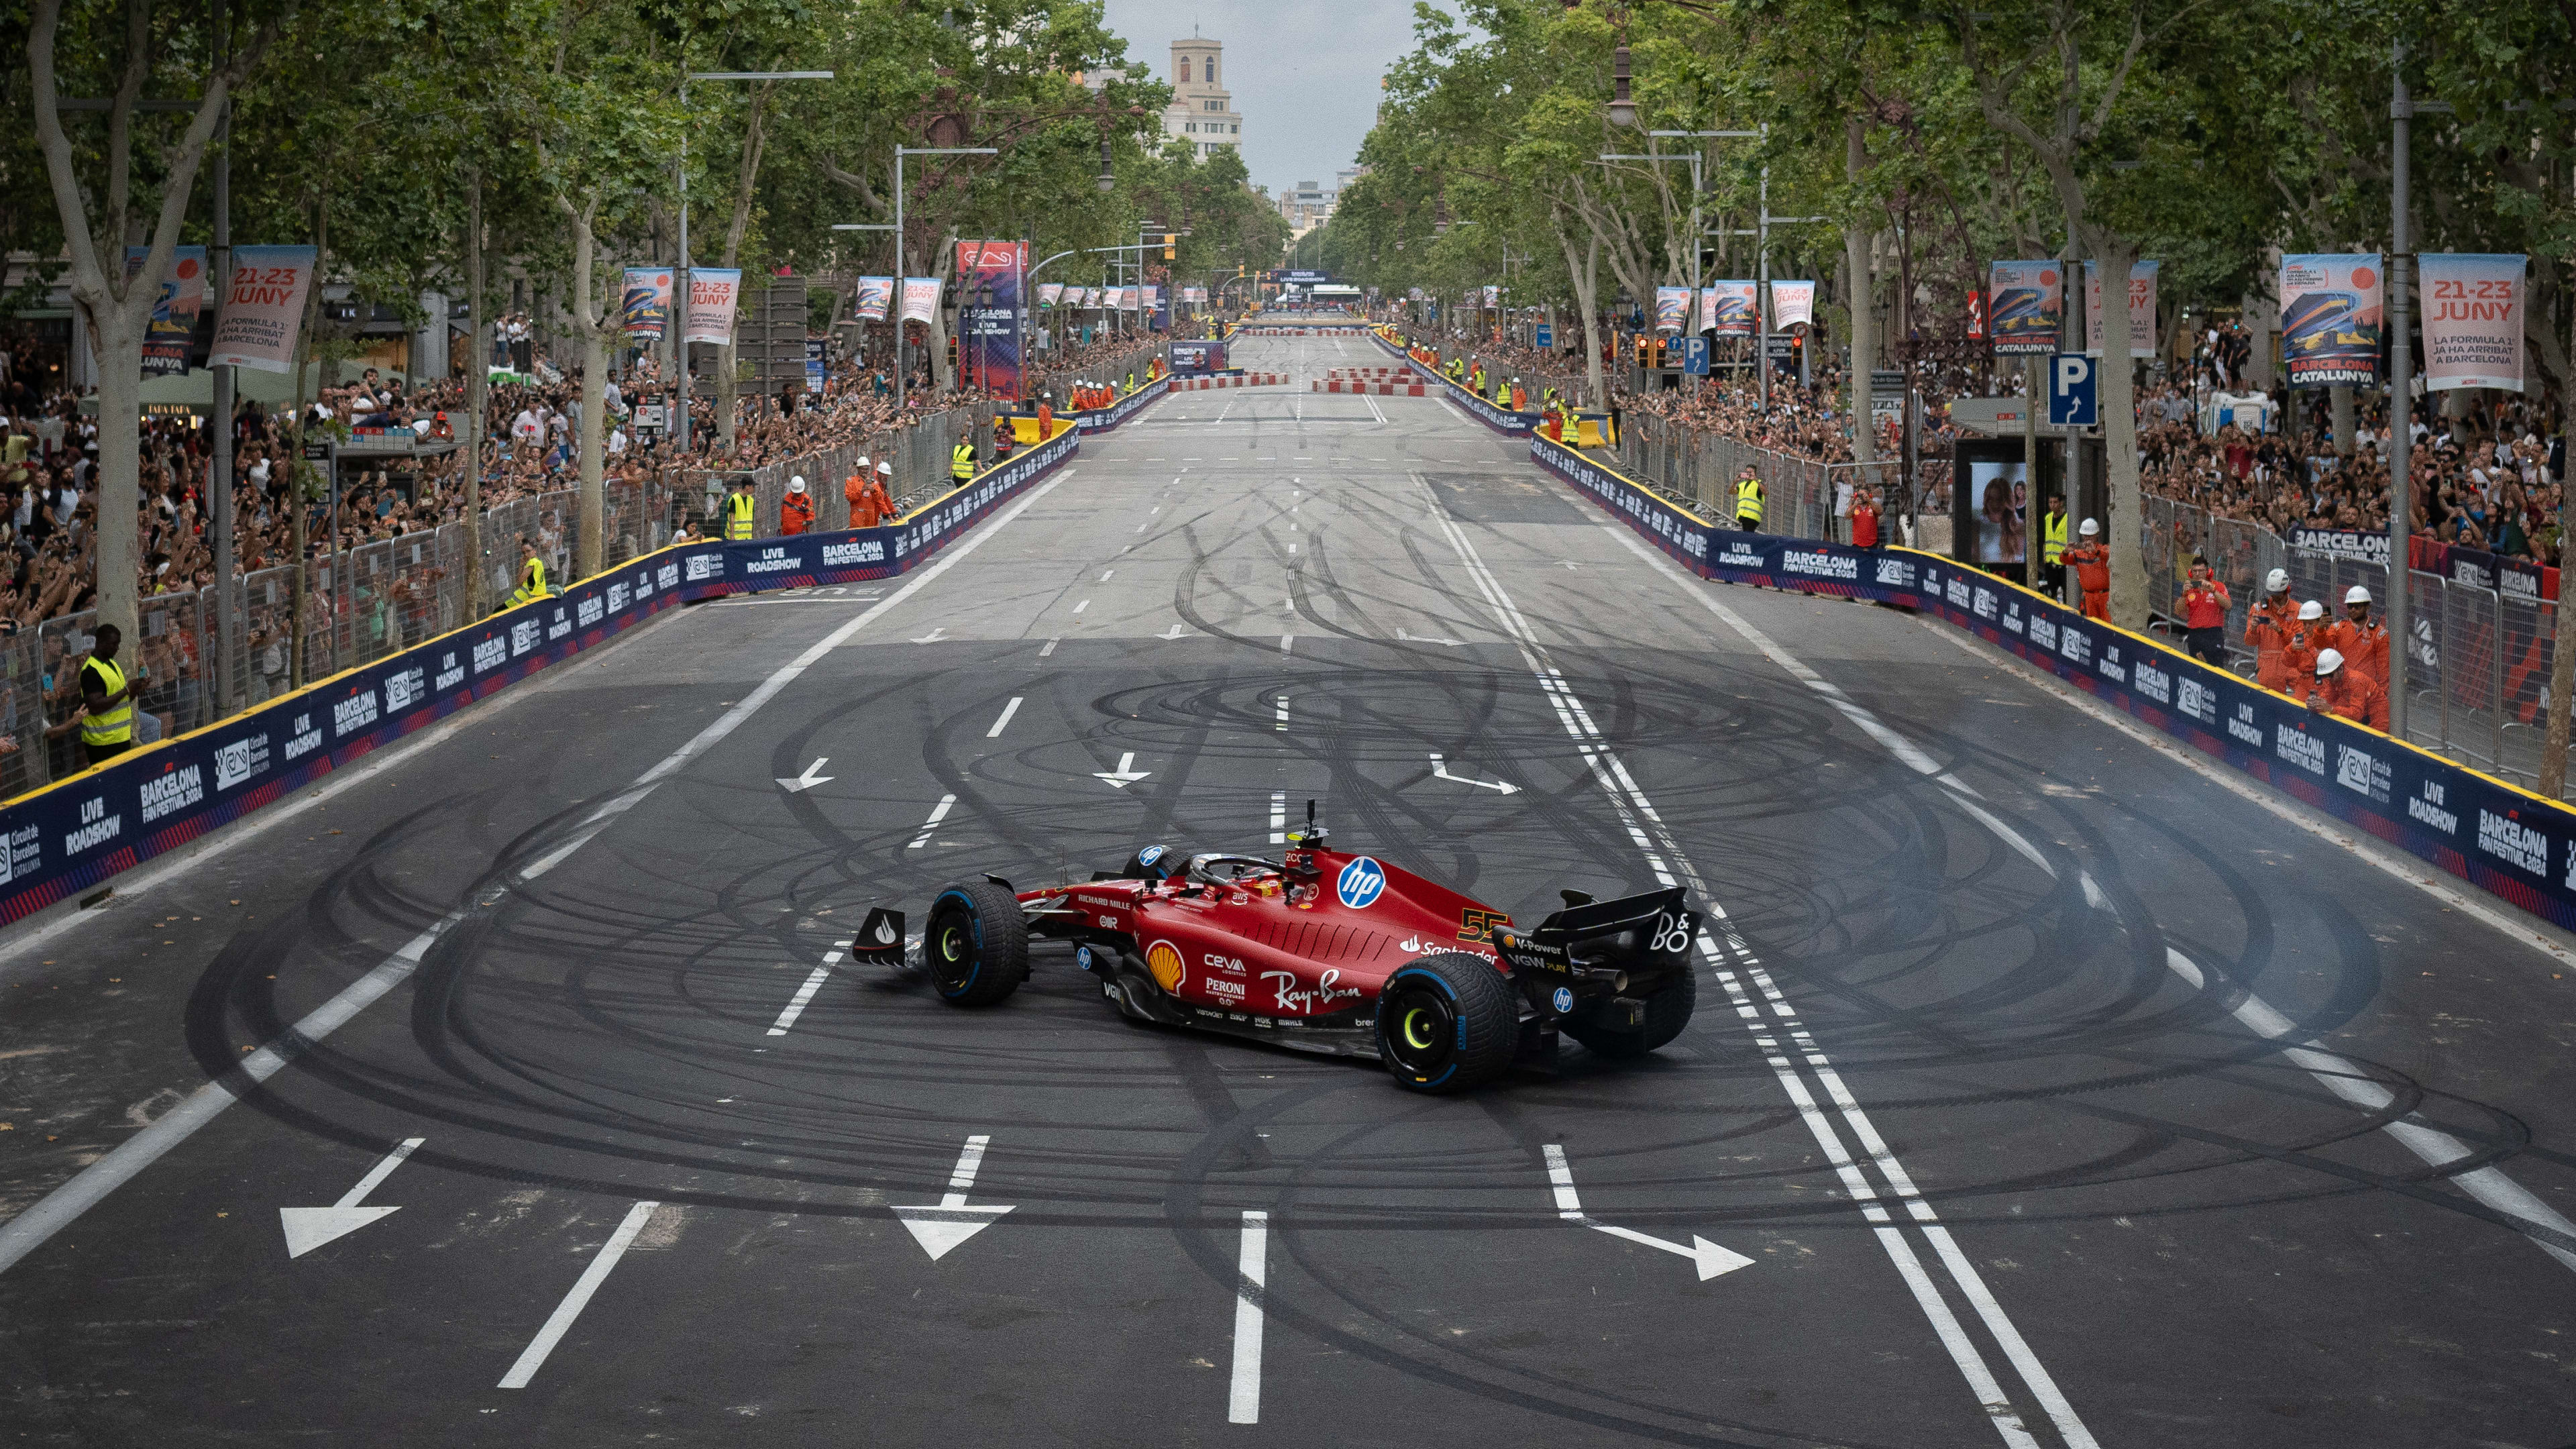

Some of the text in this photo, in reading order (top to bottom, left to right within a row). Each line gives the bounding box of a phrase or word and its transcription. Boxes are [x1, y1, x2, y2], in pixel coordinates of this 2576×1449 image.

[235, 268, 297, 286] 21-23
[228, 287, 294, 307] JUNY
[693, 282, 731, 294] 21-23
[2434, 280, 2512, 299] 21-23
[690, 294, 730, 306] JUNY
[1777, 294, 1808, 304] JUNY
[2433, 302, 2513, 321] JUNY
[230, 317, 278, 328] FORMULA
[1688, 339, 1705, 358] P
[1995, 343, 2056, 353] CATALUNYA
[1996, 337, 2055, 345] BARCELONA
[2434, 336, 2447, 345] LA
[2450, 335, 2506, 345] FORMULA
[2434, 345, 2445, 356] JA
[2467, 345, 2514, 355] ARRIBAT
[2436, 354, 2512, 365] A BARCELONA
[2291, 359, 2373, 372] BARCELONA
[2059, 358, 2088, 396] P
[2292, 370, 2373, 384] CATALUNYA
[823, 541, 883, 558] BARCELONA
[1732, 541, 1751, 554] LIVE
[2296, 530, 2391, 553] BARCELON
[763, 547, 785, 559] LIVE
[824, 552, 884, 566] FAN FESTIVAL 2024
[1719, 551, 1764, 568] ROADSHOW
[1784, 550, 1858, 571] BARCELONA
[747, 557, 802, 574] ROADSHOW
[1783, 561, 1858, 580] FAN FESTIVAL 2024
[2031, 614, 2055, 639] BARCELONA
[473, 635, 506, 661] BARCELONA
[2108, 645, 2118, 663] LIVE
[443, 651, 455, 670] LIVE
[436, 665, 464, 692] ROADSHOW
[2135, 661, 2169, 691] BARCELONA
[334, 690, 377, 724] BARCELONA
[2239, 702, 2253, 724] LIVE
[294, 712, 310, 736] LIVE
[2229, 717, 2262, 747] ROADSHOW
[285, 728, 321, 761] ROADSHOW
[2278, 723, 2324, 762] BARCELONA
[2277, 743, 2324, 776] FAN FESTIVAL 2024
[140, 763, 201, 807] BARCELONA
[2371, 772, 2390, 792] Barcelona
[2424, 780, 2444, 806] LIVE
[81, 796, 103, 824] LIVE
[142, 785, 203, 824] FAN FESTIVAL 2024
[2409, 796, 2457, 835] ROADSHOW
[11, 823, 39, 846] Circuit de
[66, 814, 121, 856] ROADSHOW
[2479, 808, 2547, 861] BARCELONA
[13, 843, 40, 863] Barcelona
[1142, 847, 1161, 865] hp
[2478, 833, 2546, 878] FAN FESTIVAL 2024
[13, 857, 41, 879] CATALUNYA
[1342, 857, 1382, 908] hp
[1078, 894, 1130, 911] RICHARD MILLE
[1233, 892, 1248, 902] aws
[1456, 908, 1507, 946] 55
[1517, 938, 1562, 955] V-Power
[1079, 947, 1091, 970] hp
[1508, 953, 1566, 973] VGW PLAY
[1104, 982, 1121, 1001] VGW
[1206, 977, 1245, 995] PERONI
[1260, 969, 1362, 1014] Ray-Ban
[1556, 988, 1570, 1012] hp
[1278, 1018, 1303, 1026] MAHLE
